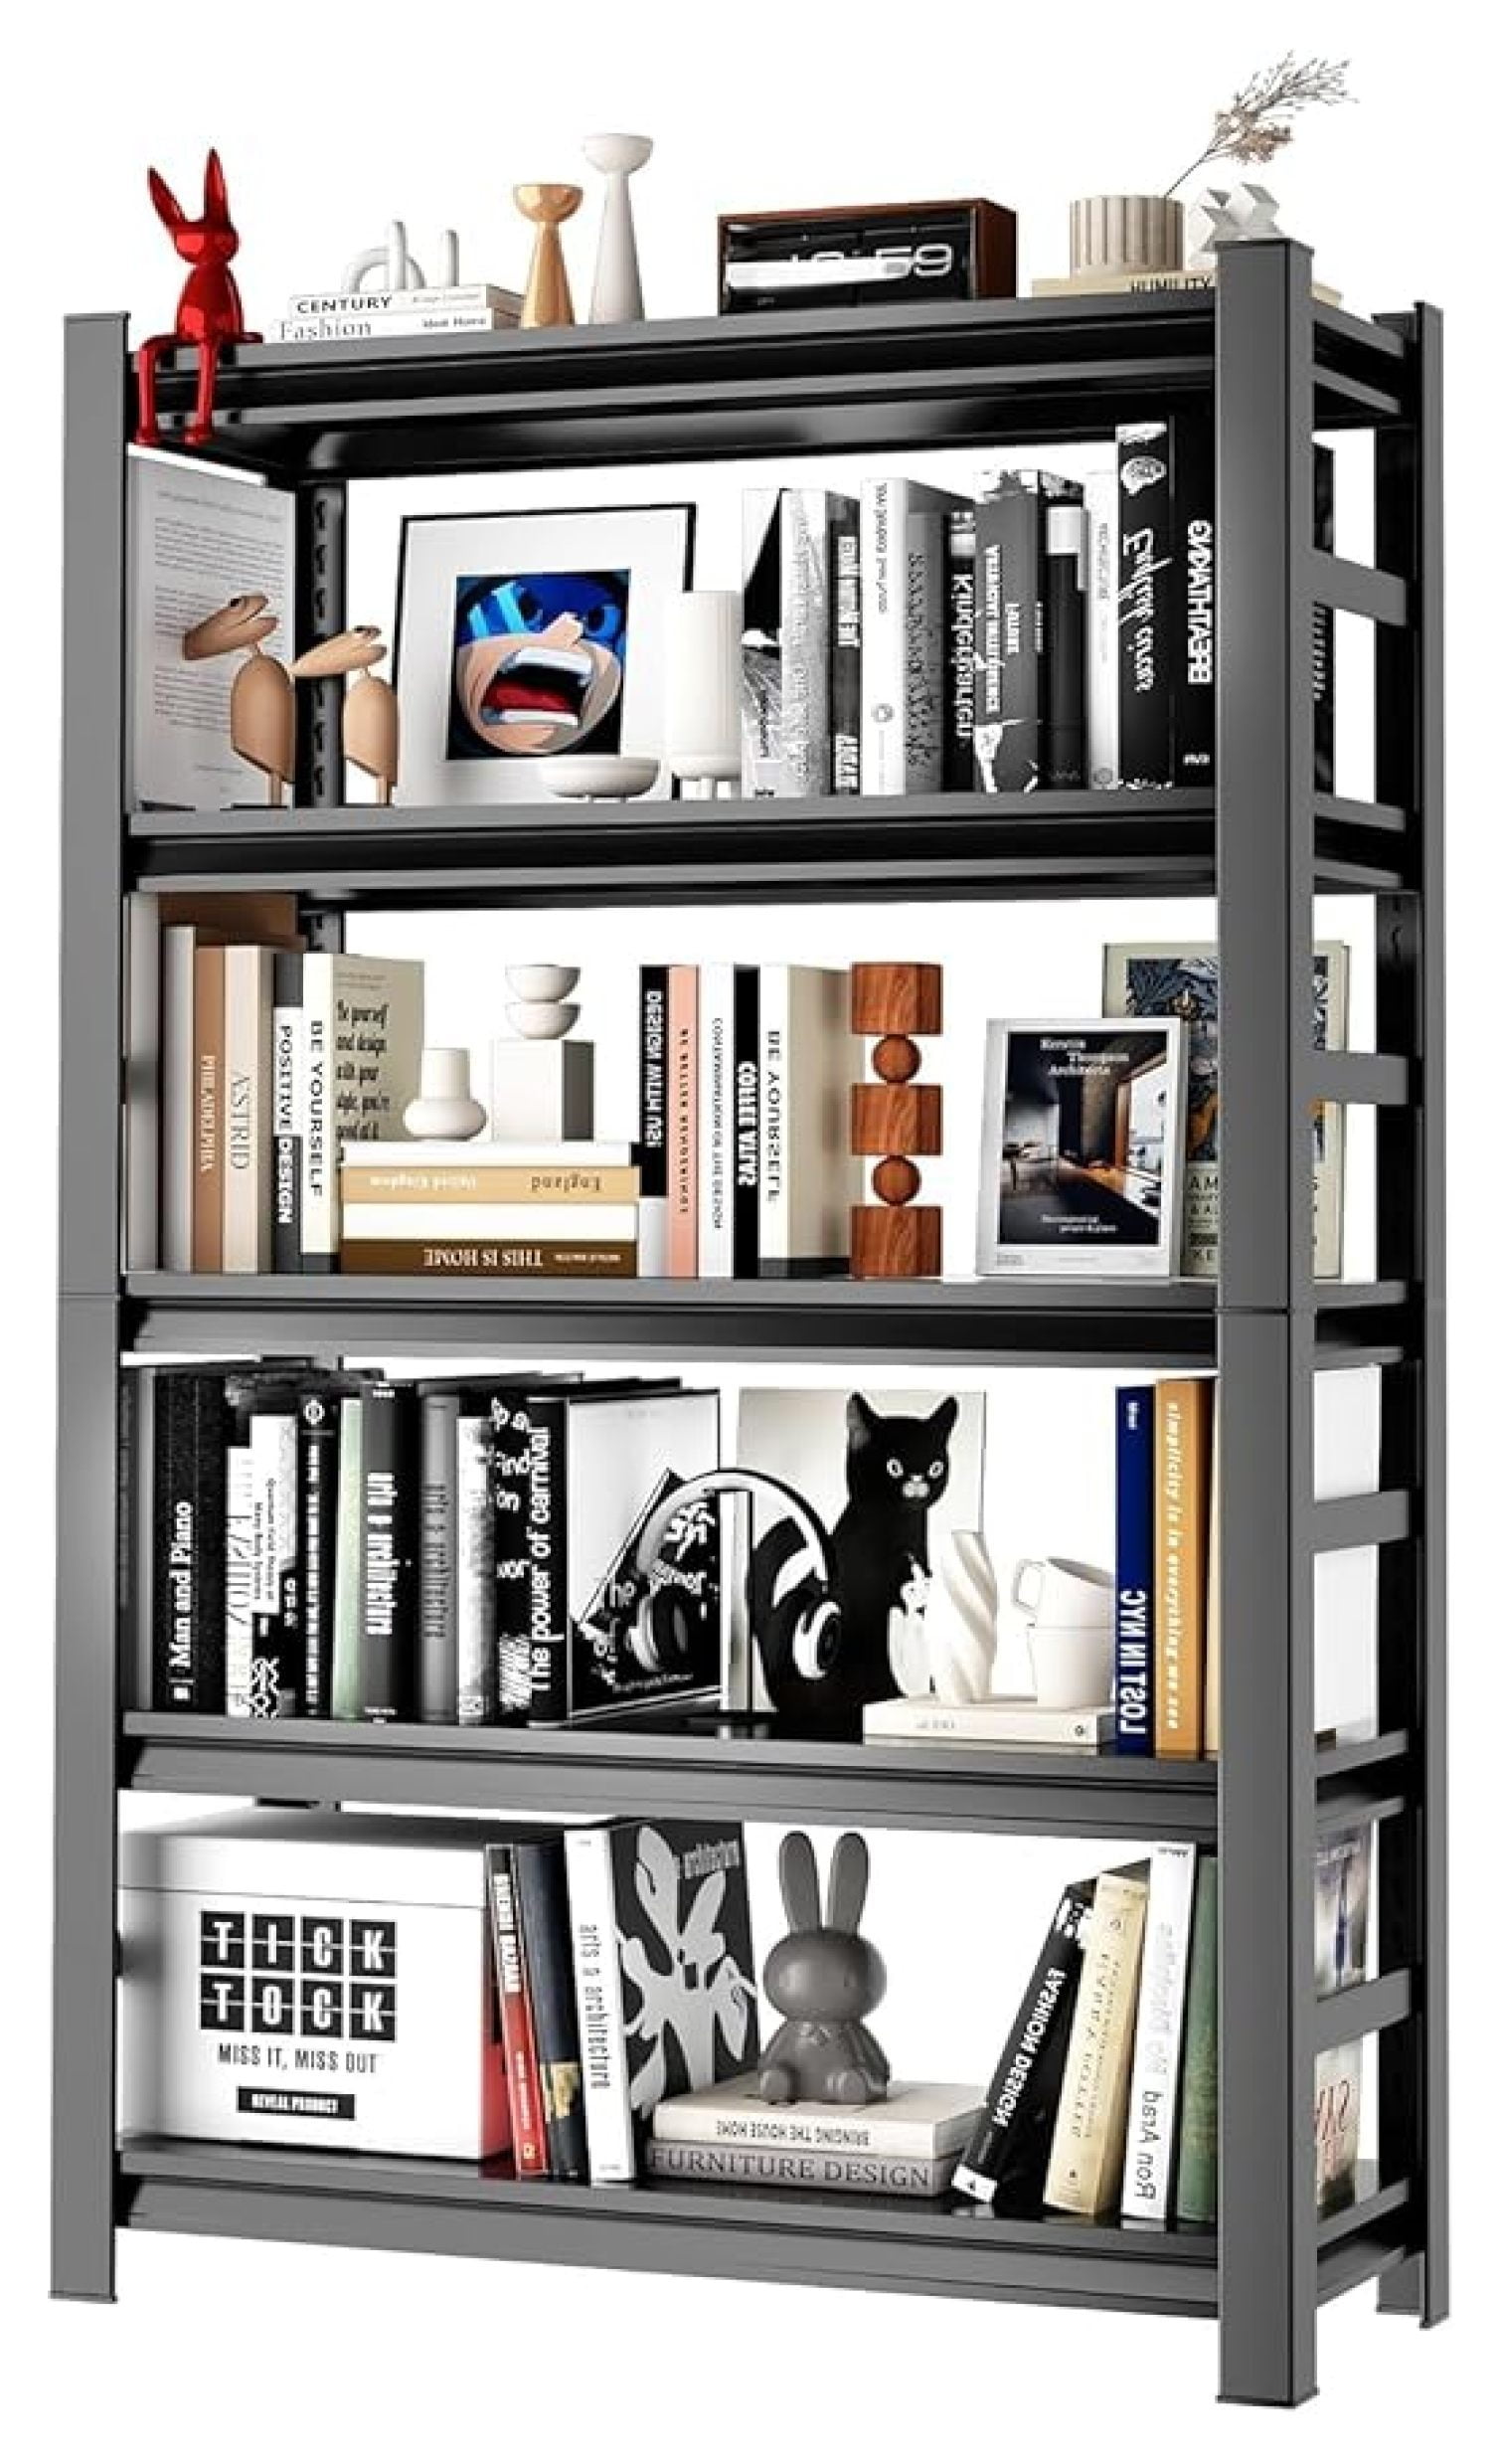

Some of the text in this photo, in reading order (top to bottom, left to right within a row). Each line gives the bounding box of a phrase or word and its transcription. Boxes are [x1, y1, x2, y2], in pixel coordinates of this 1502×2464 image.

[296, 295, 393, 315] CENTURY
[279, 319, 372, 341] Fashion
[351, 1003, 390, 1029] yourself
[200, 1054, 216, 1173] PHILADELPHIA
[230, 1071, 251, 1170] ASTRID
[278, 1024, 294, 1224] POSITIVE DESIGN
[310, 1019, 324, 1198] BE YOURSELF
[531, 1173, 601, 1193] England
[422, 1248, 544, 1267] THIS IS HOME
[1165, 1401, 1184, 1500] simplicity
[265, 1478, 276, 1524] Quantum
[1166, 1503, 1183, 1522] is
[526, 1425, 565, 1690] The power of carnival
[1166, 1528, 1183, 1547] in
[168, 1500, 193, 1669] Man and Piano
[252, 1560, 263, 1600] Systems
[1165, 1553, 1183, 1660] everything
[213, 1918, 387, 1972] TICK
[580, 1924, 602, 1958] arts
[213, 1981, 387, 2034] TOCK
[217, 2042, 378, 2075] MISS IT, MISS OUT
[584, 1986, 611, 2089] architecture
[716, 2120, 870, 2147] BRINGING THE HOUSE HOME
[650, 2147, 929, 2189] FURNITURE DESIGN
